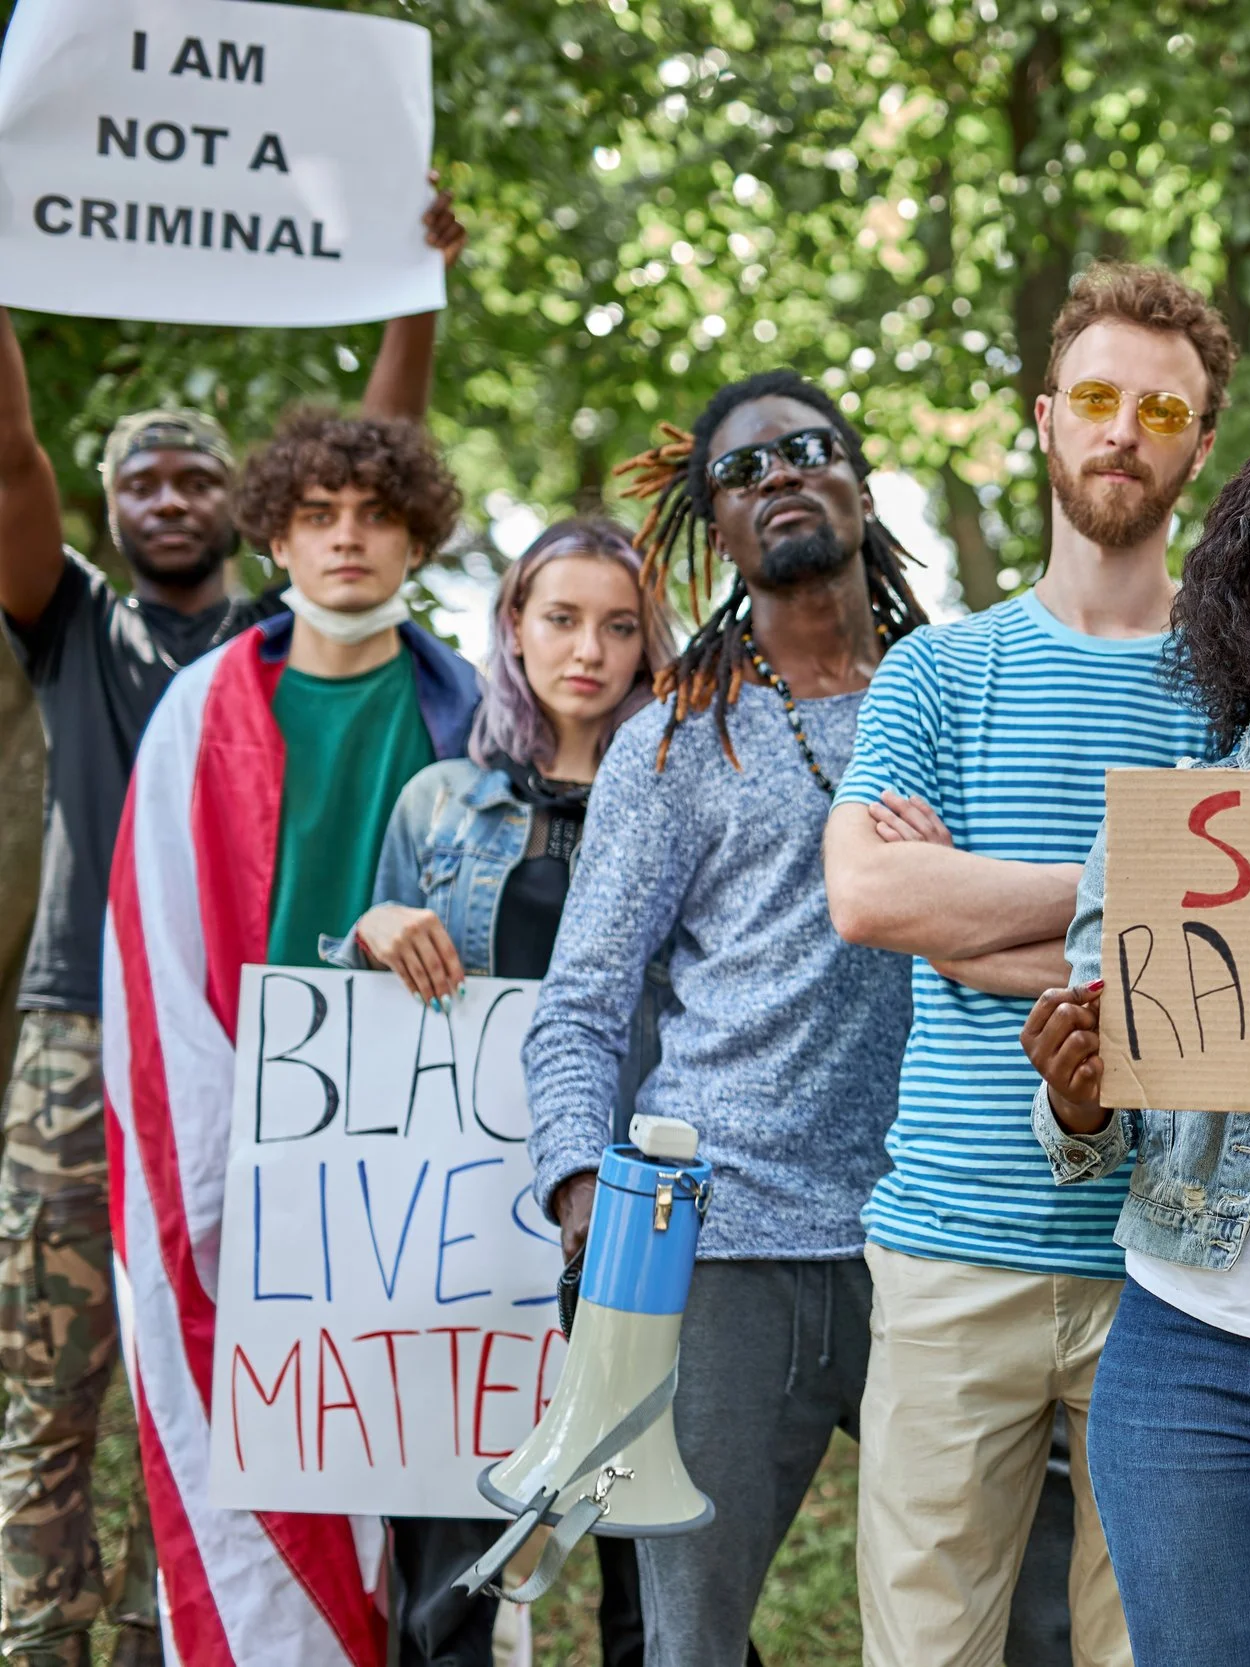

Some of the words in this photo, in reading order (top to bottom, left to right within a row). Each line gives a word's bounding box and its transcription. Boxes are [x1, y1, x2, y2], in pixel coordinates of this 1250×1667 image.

[131, 29, 148, 72] I
[169, 36, 266, 85] AM
[97, 114, 230, 167] NOT
[248, 132, 290, 175] A
[32, 193, 343, 261] CRIMINAL
